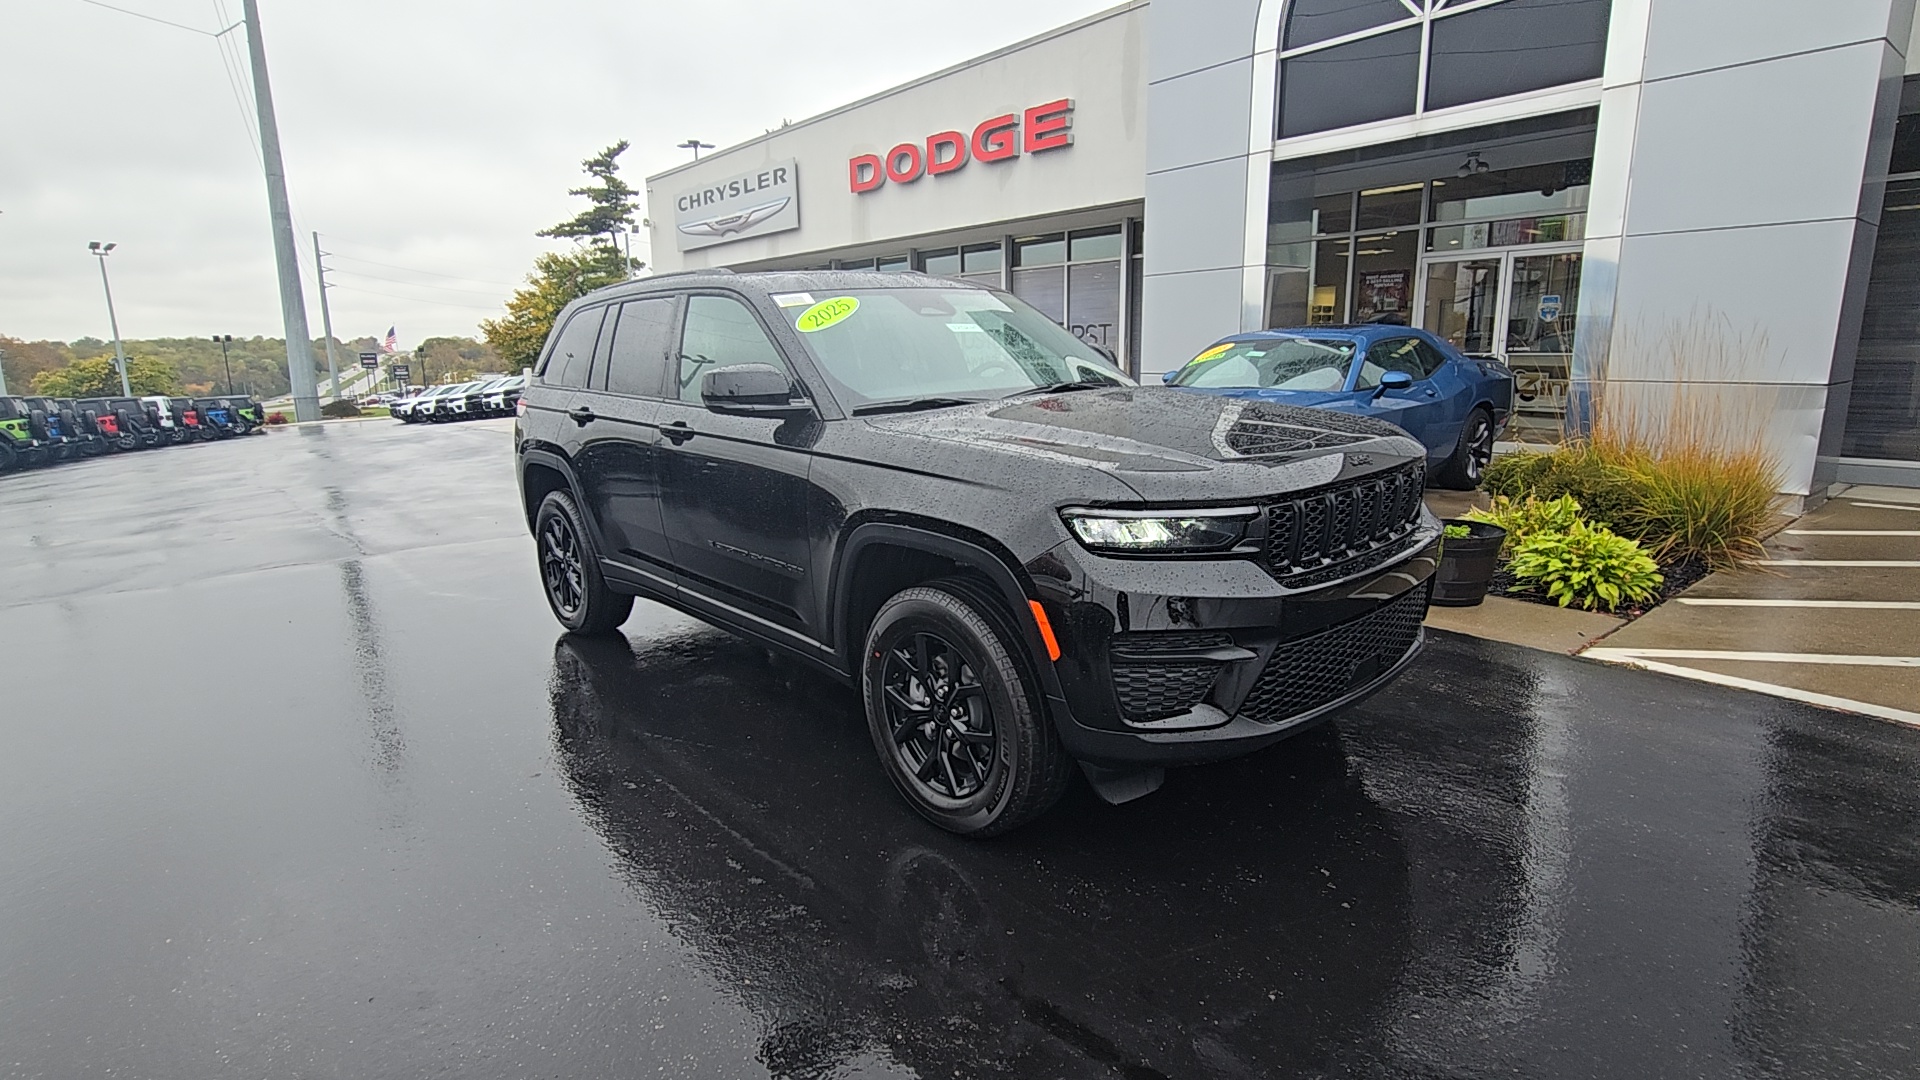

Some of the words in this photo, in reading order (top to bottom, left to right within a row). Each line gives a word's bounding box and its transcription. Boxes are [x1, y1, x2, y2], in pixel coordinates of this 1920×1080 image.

[850, 98, 1074, 193] DODGE
[678, 167, 787, 212] CHRYSLER
[808, 300, 851, 327] 2025
[1058, 322, 1112, 345] RST
